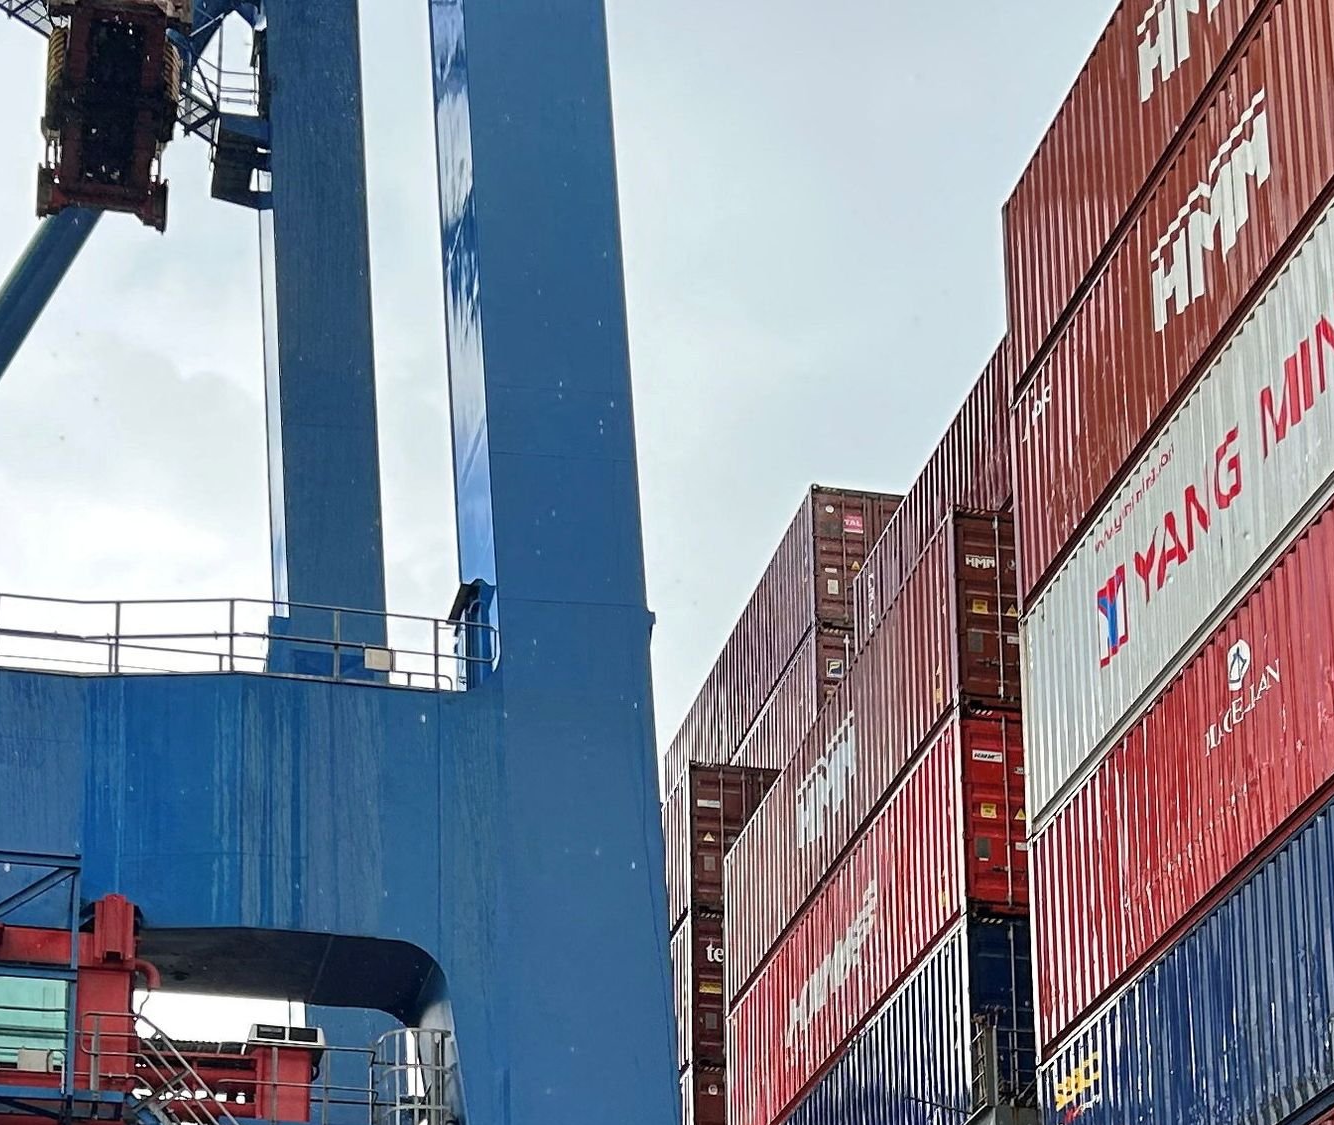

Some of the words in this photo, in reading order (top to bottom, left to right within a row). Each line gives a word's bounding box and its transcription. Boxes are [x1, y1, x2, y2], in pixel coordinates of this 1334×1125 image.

[1151, 88, 1271, 333] HMM
[965, 554, 996, 569] HMM
[1134, 425, 1243, 604] YANG
